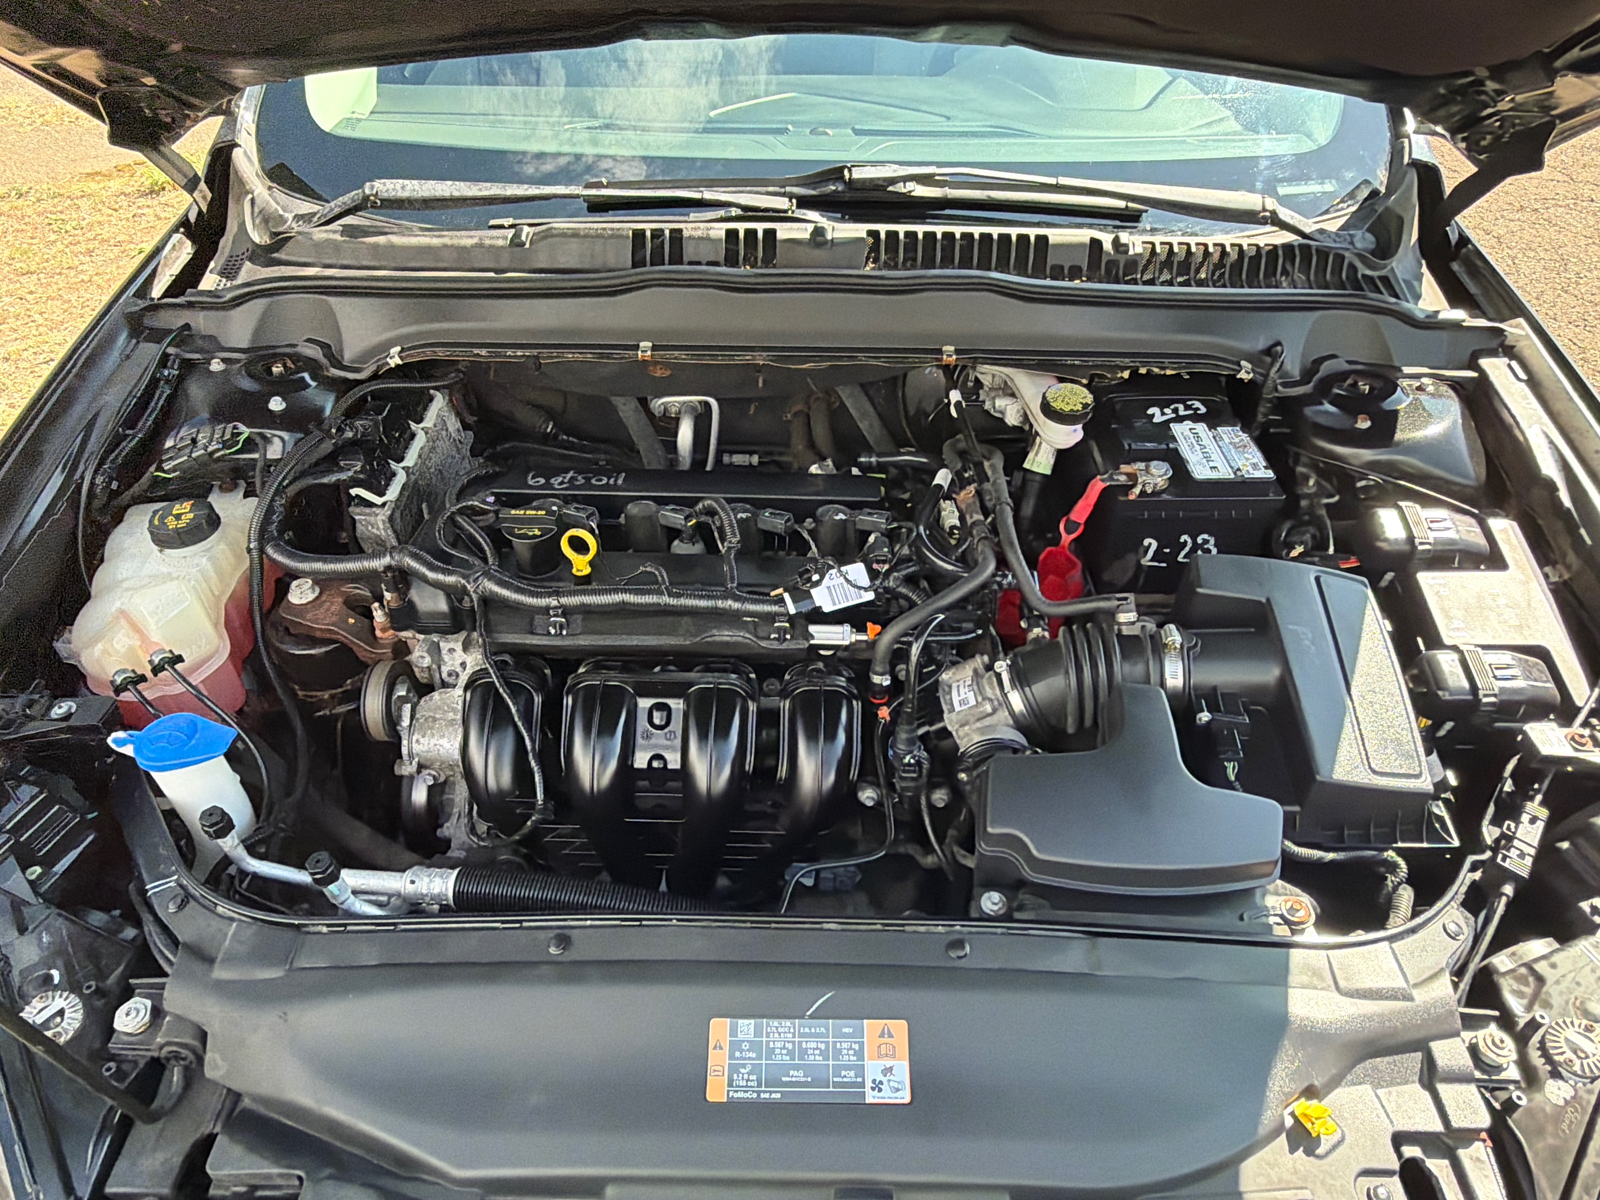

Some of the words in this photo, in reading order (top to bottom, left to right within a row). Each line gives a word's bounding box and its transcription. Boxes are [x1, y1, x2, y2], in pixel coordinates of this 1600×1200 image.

[1188, 427, 1221, 474] USABLE
[1140, 533, 1218, 567] 2-23
[785, 1041, 793, 1050] kg
[817, 1041, 825, 1050] kg
[851, 1042, 859, 1050] kg
